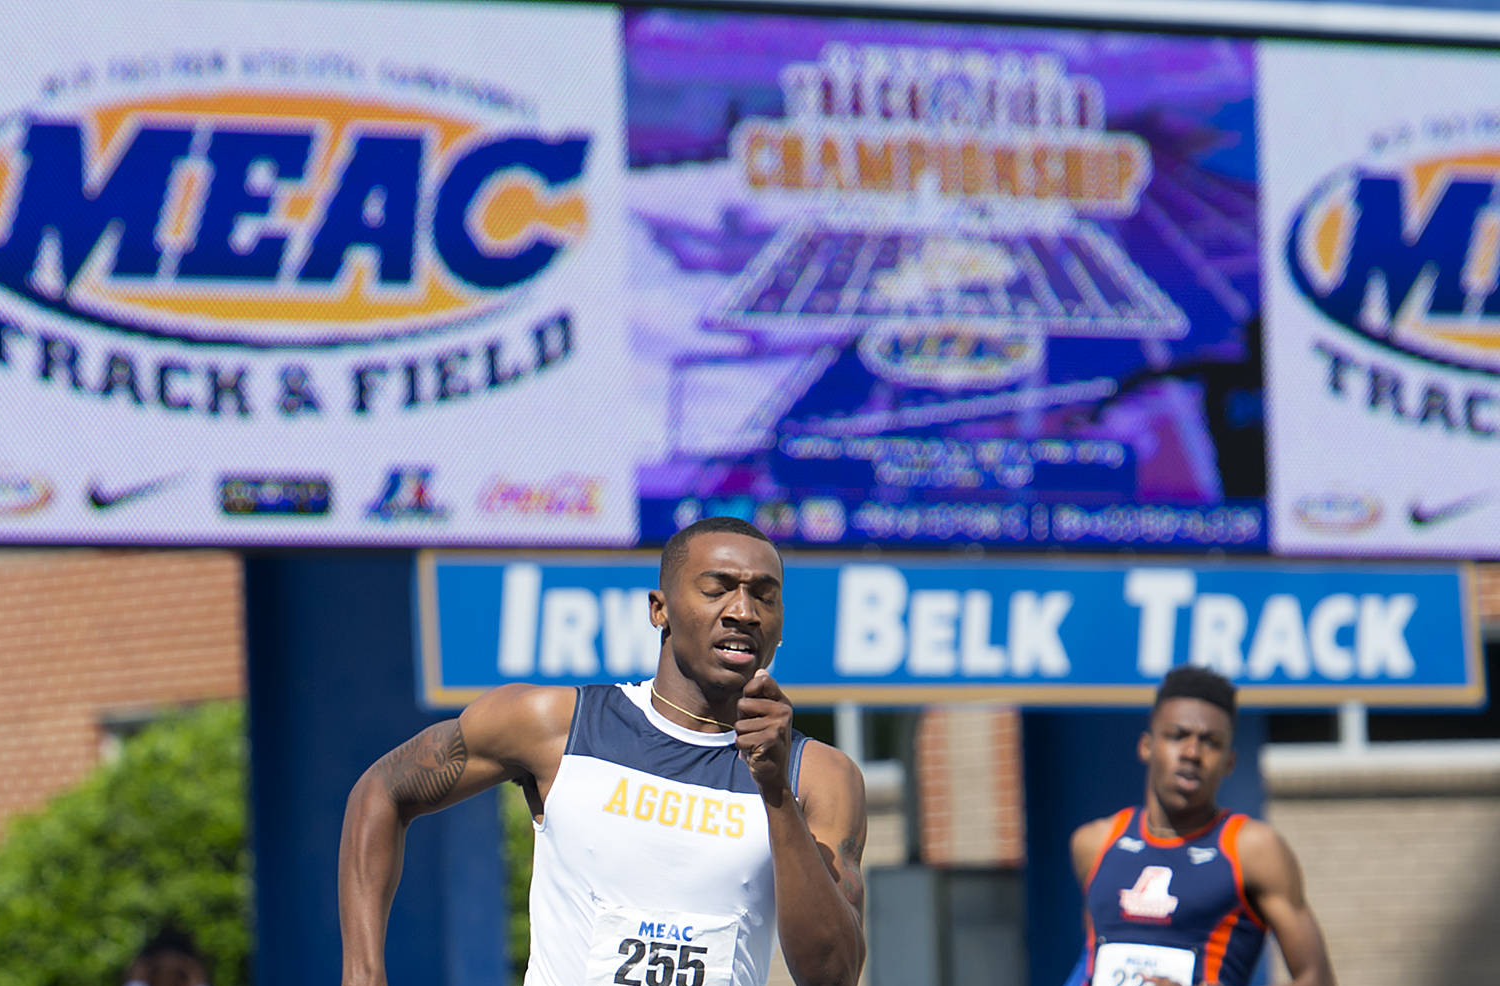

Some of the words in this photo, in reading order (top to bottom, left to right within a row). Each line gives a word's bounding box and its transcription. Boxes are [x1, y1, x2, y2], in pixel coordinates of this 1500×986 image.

[748, 132, 1136, 200] CHAMPIONSHIP
[277, 366, 322, 414] &
[350, 310, 574, 416] FIELD
[498, 564, 672, 679] IRW
[835, 564, 1073, 677] BELK
[1124, 567, 1418, 681] TRACK
[604, 776, 746, 839] AGGIES
[638, 920, 694, 942] MEAC
